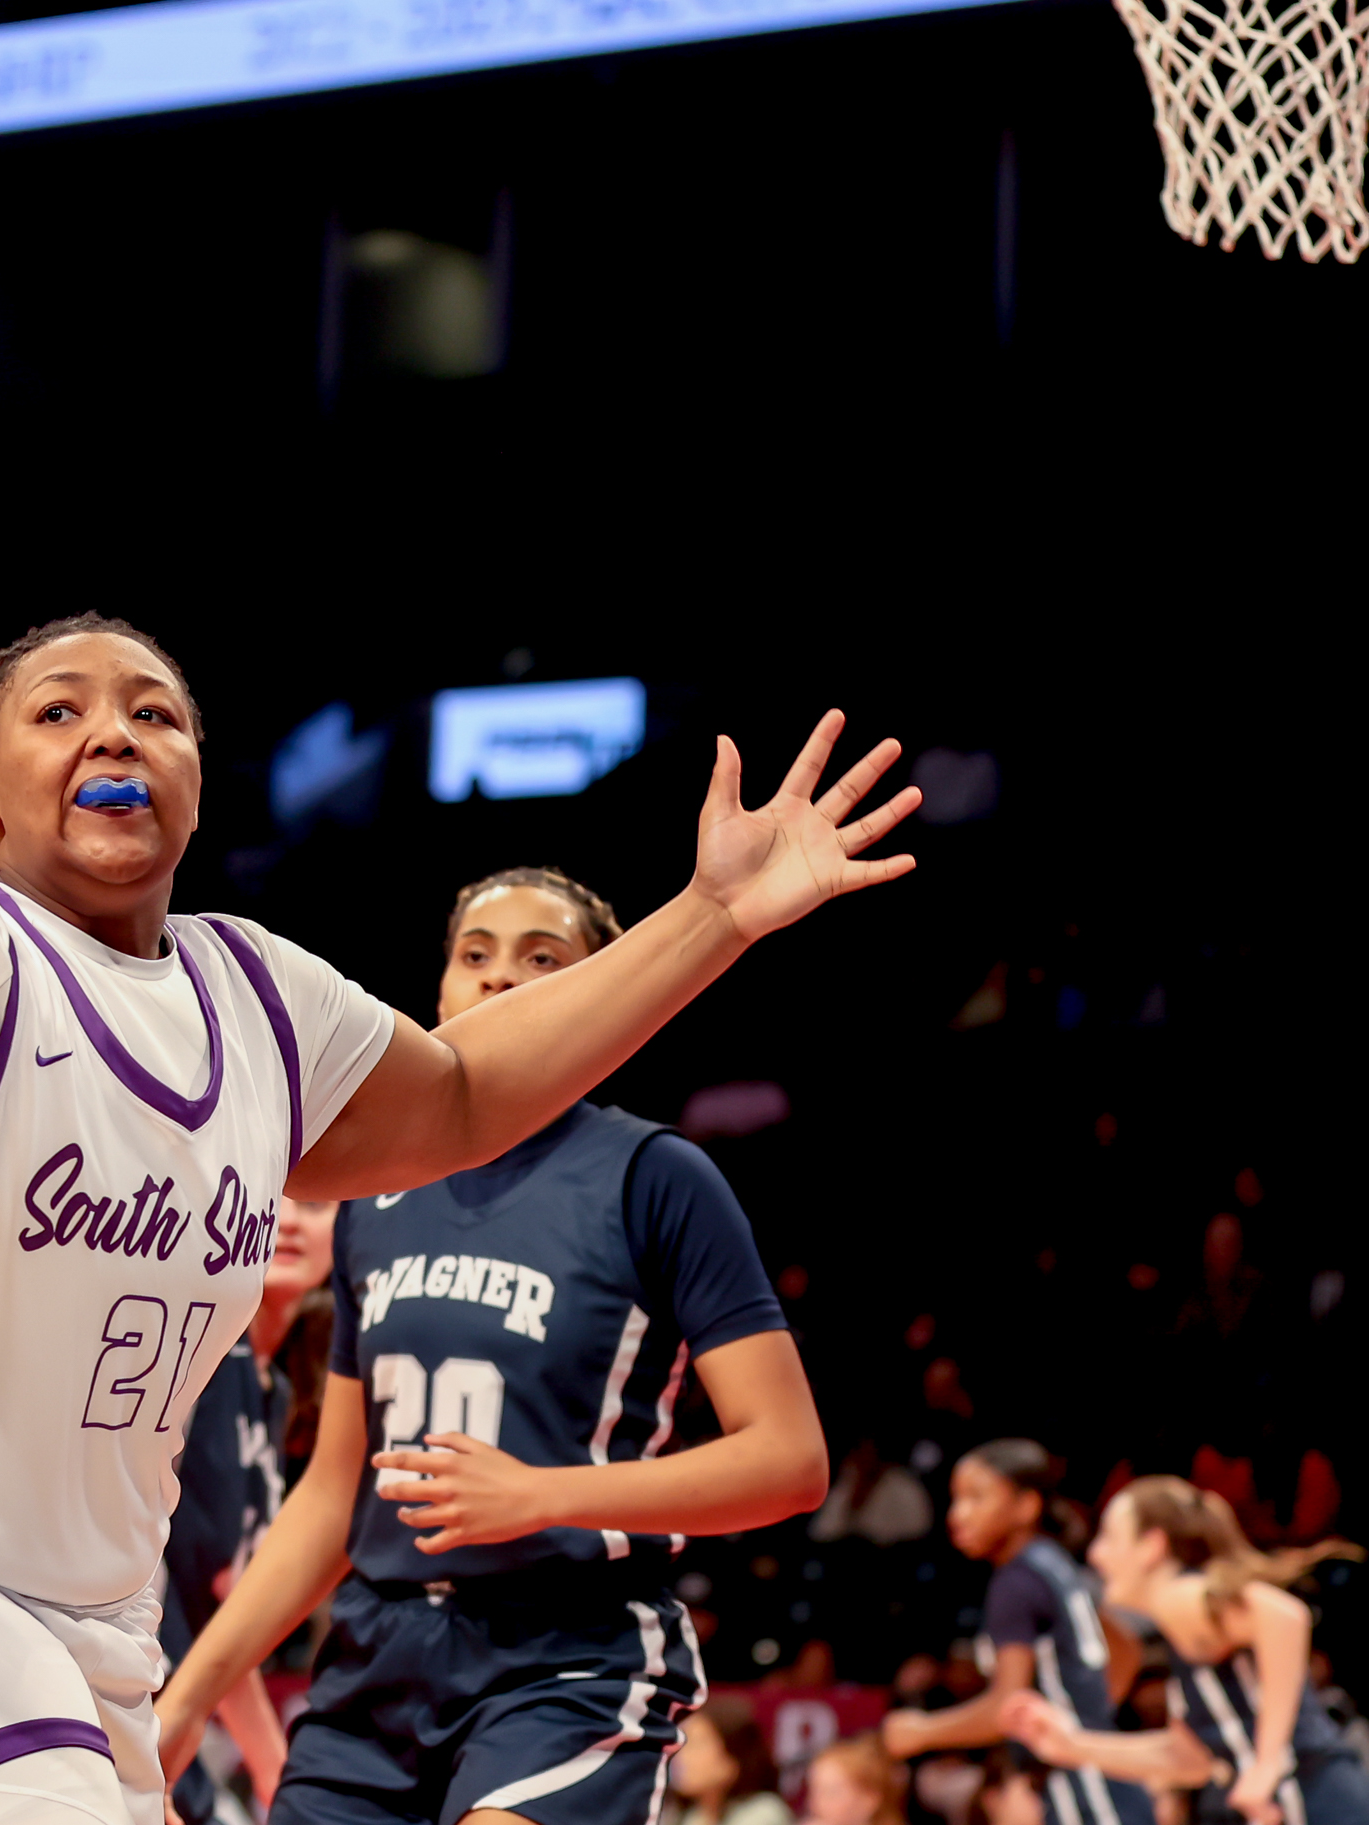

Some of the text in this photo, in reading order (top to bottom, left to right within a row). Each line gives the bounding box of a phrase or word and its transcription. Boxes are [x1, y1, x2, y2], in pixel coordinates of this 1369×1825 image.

[18, 1142, 276, 1276] South Shor
[81, 1294, 216, 1433] 21
[361, 1254, 555, 1343] WAGNER
[372, 1353, 505, 1492] 20
